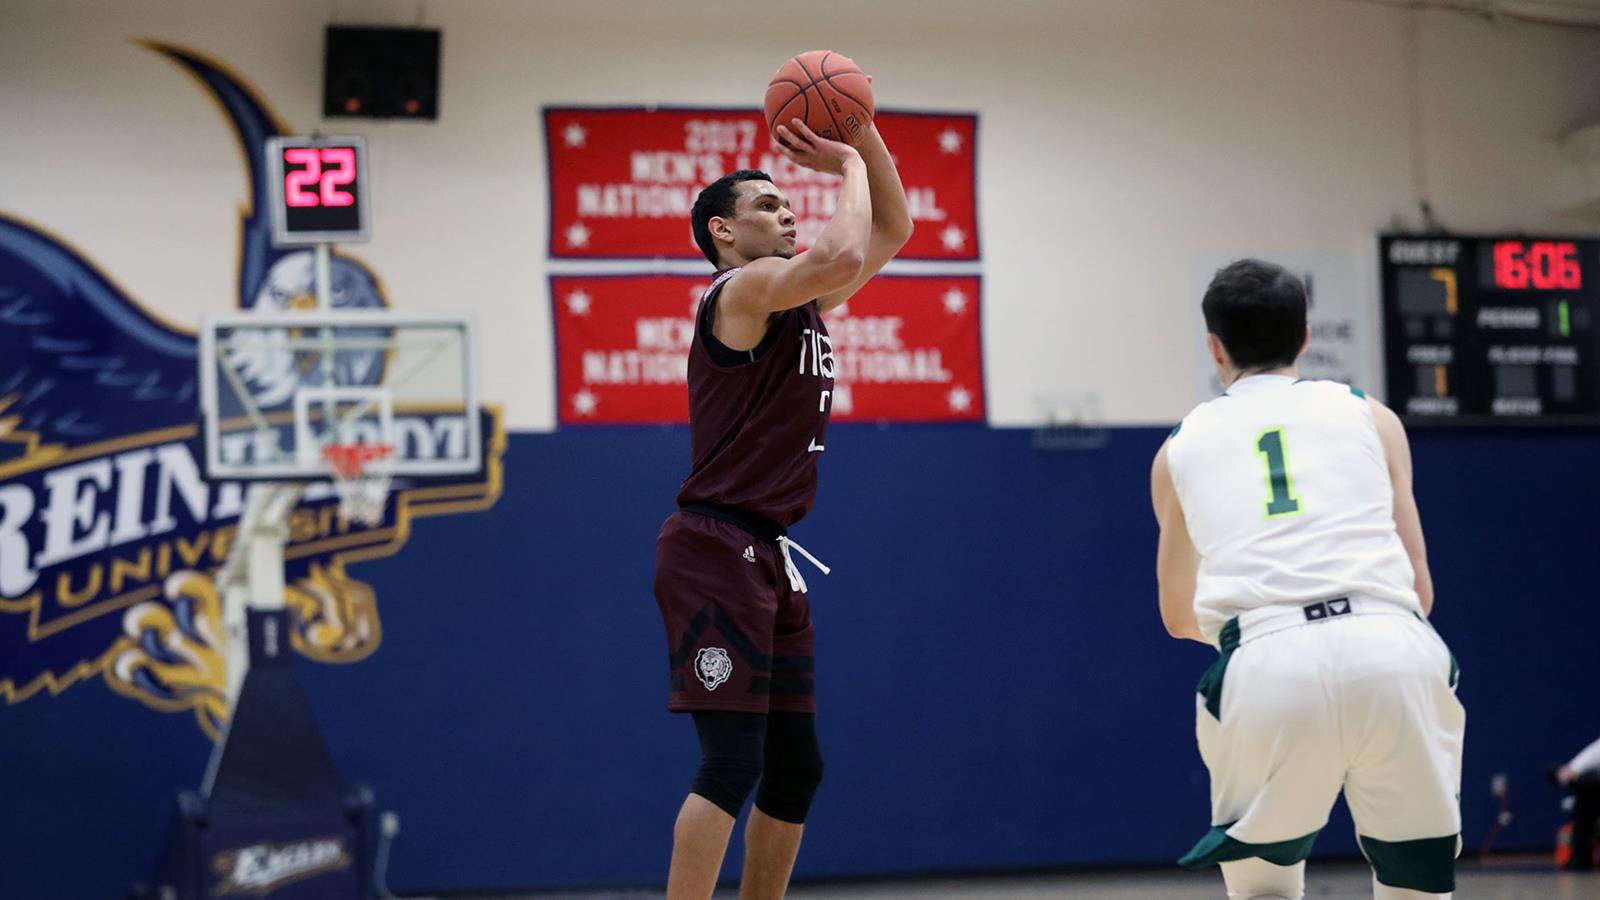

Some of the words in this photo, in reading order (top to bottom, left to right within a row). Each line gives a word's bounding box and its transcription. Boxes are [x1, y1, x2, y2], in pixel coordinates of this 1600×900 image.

[685, 120, 756, 152] 2017
[284, 148, 356, 207] 22
[632, 152, 724, 184] MEN'S
[577, 184, 703, 219] NATION
[637, 317, 697, 350] MEN
[1477, 307, 1540, 329] PERIOD
[583, 350, 689, 385] NATION
[1254, 425, 1302, 521] 1
